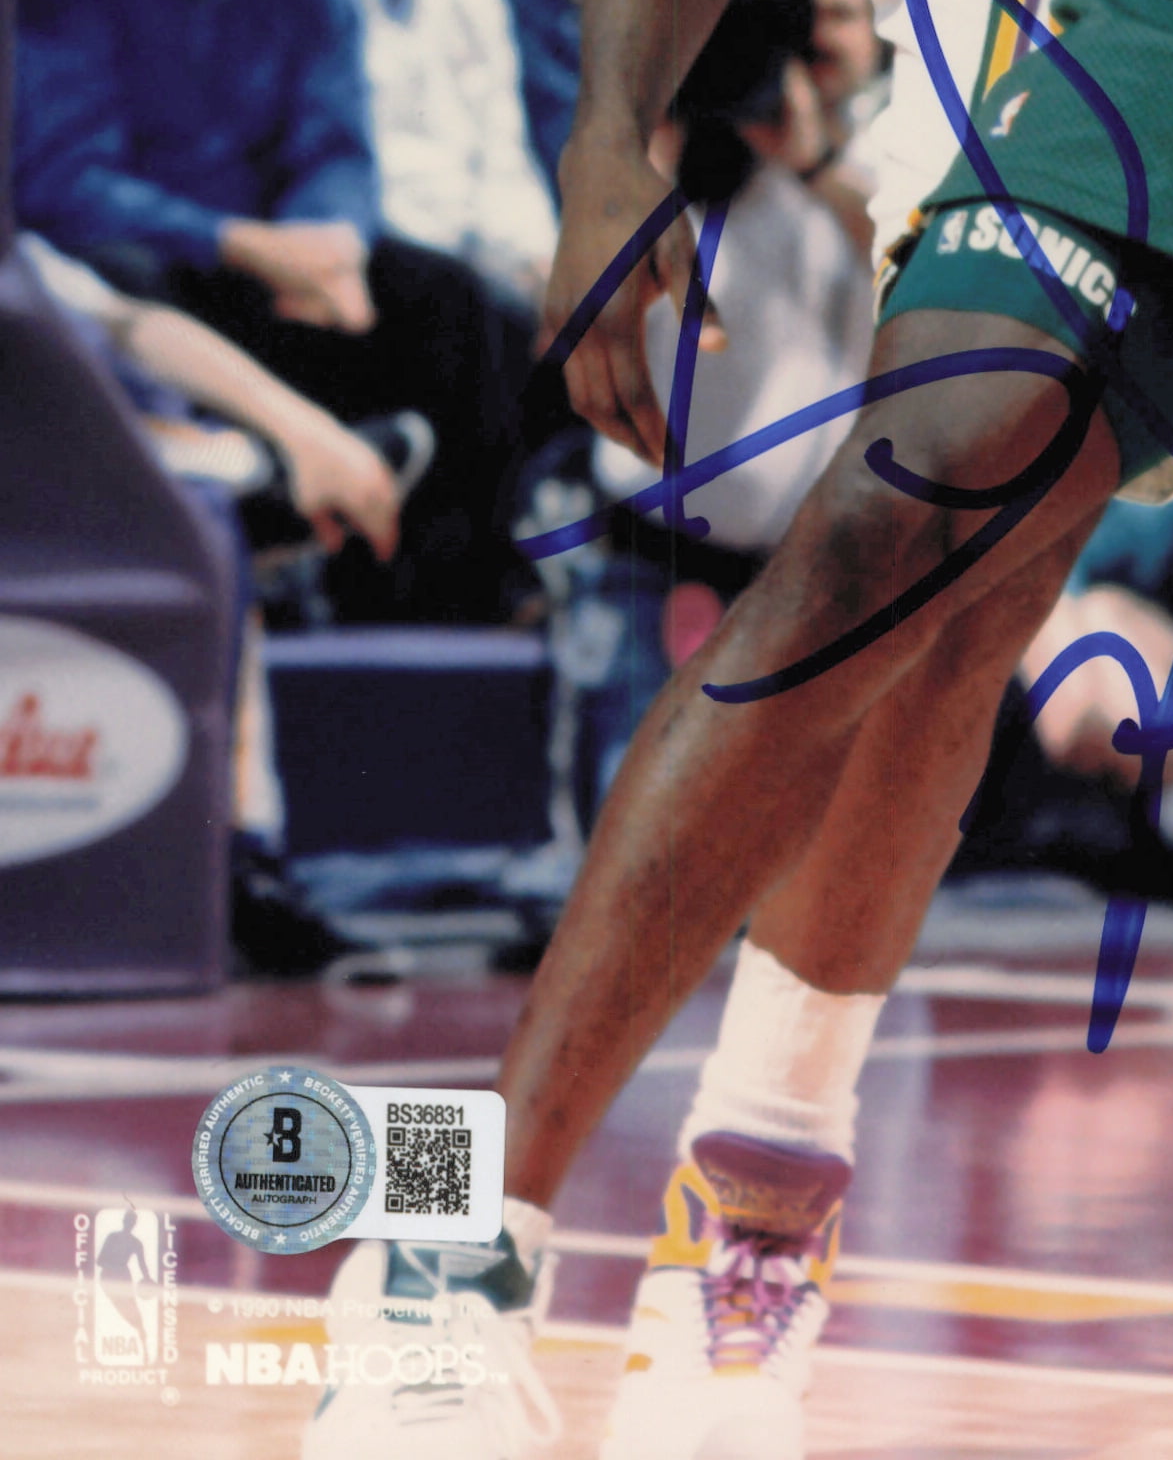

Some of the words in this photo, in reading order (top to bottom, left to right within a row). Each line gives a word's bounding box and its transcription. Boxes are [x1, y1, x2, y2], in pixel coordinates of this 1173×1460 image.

[205, 1075, 265, 1130] AUTHENTIC
[304, 1076, 355, 1119] BECKETT
[386, 1102, 464, 1126] BS36831
[198, 1131, 216, 1196] VERIFIED
[350, 1119, 367, 1184] VERIFIED
[234, 1173, 336, 1193] AUTHENTICATED
[251, 1193, 318, 1205] AUTOGRAPH
[210, 1196, 260, 1240] BECKETT
[300, 1188, 360, 1242] AUTHENTIC
